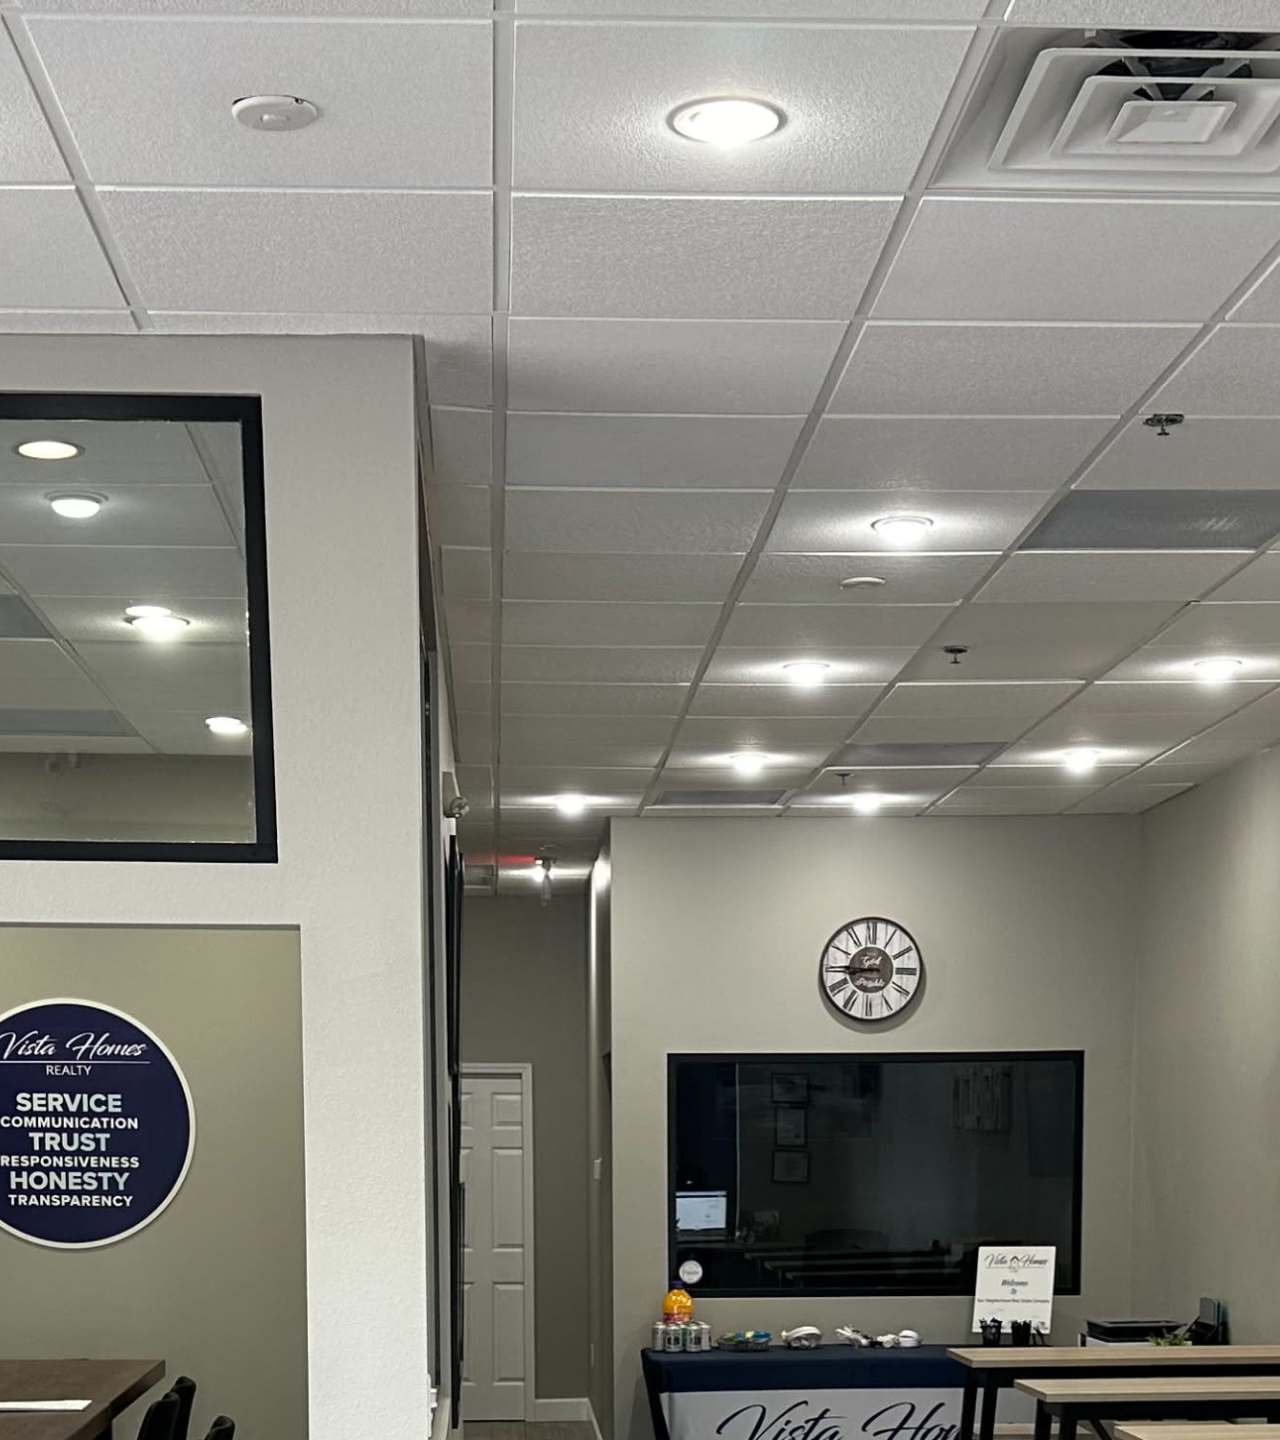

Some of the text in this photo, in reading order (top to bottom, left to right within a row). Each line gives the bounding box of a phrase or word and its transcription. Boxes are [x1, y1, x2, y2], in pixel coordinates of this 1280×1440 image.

[66, 1032, 147, 1061] Homes
[46, 1065, 92, 1076] REALTY
[16, 1092, 122, 1113] SERVICE
[0, 1116, 138, 1130] COMMUNICATION
[29, 1132, 110, 1152] TRUST
[0, 1155, 140, 1168] RESPONSIVENESS
[10, 1171, 130, 1191] HONESTY
[8, 1194, 133, 1207] TRANSPARENCY
